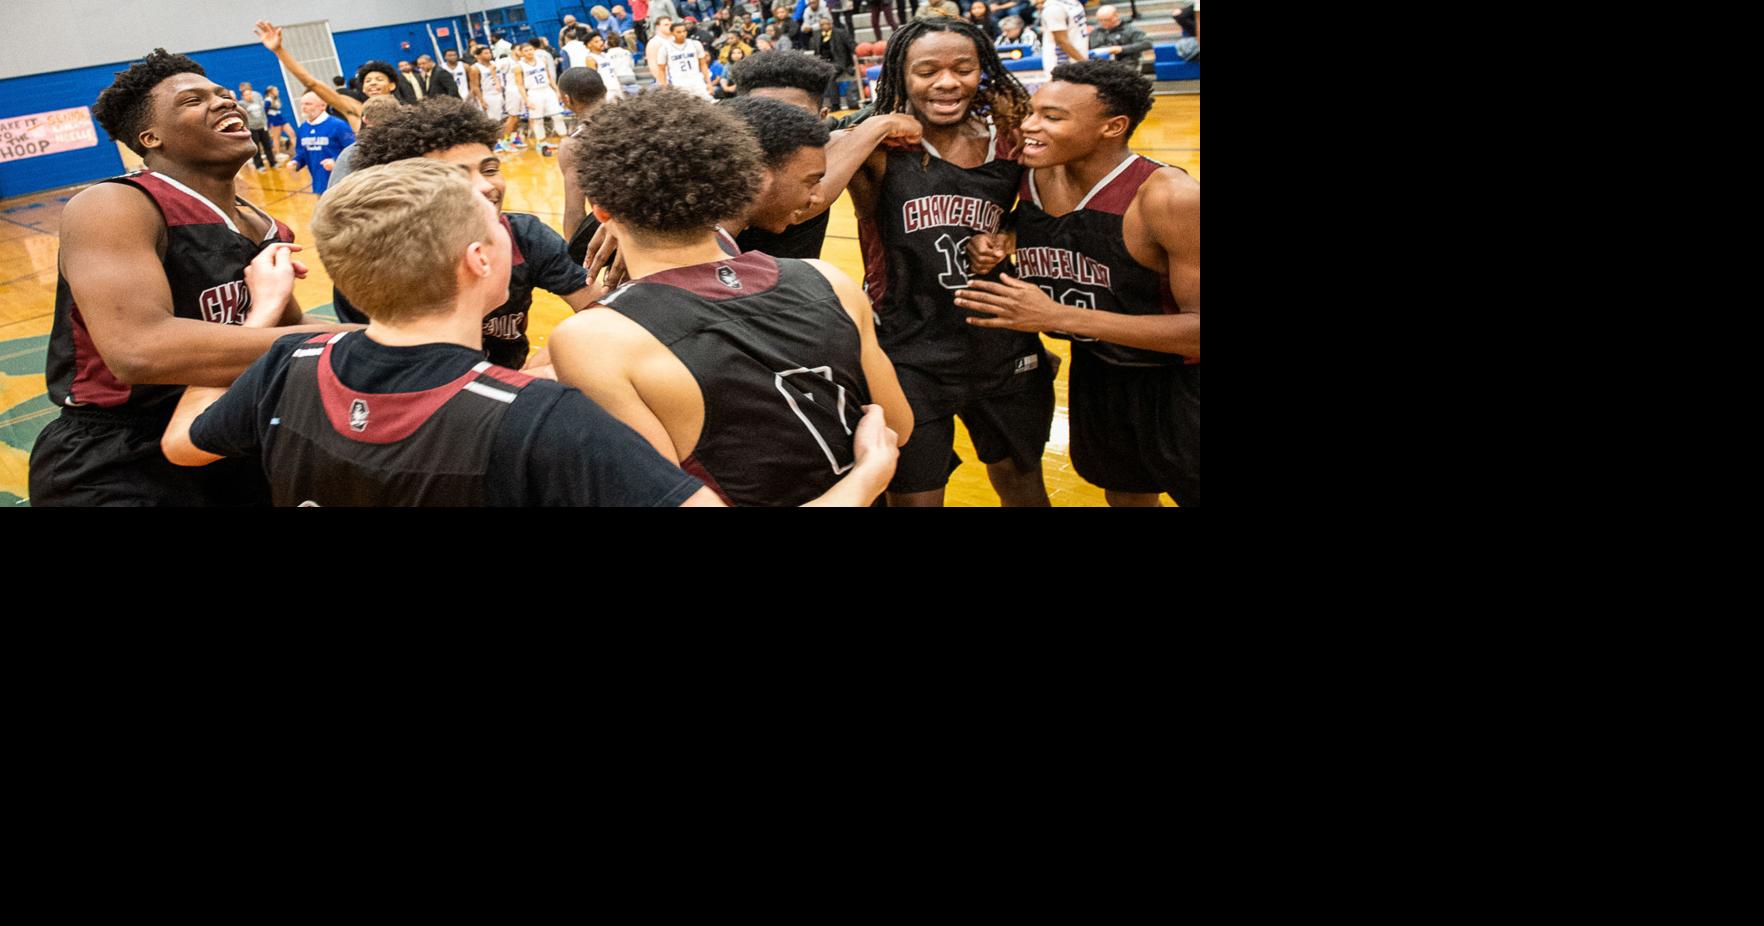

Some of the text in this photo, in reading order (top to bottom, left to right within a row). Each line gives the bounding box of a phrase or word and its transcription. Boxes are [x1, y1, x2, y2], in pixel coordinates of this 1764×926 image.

[679, 60, 692, 72] 21
[534, 74, 546, 85] 12
[0, 120, 20, 131] AKE
[0, 139, 50, 159] HOOP
